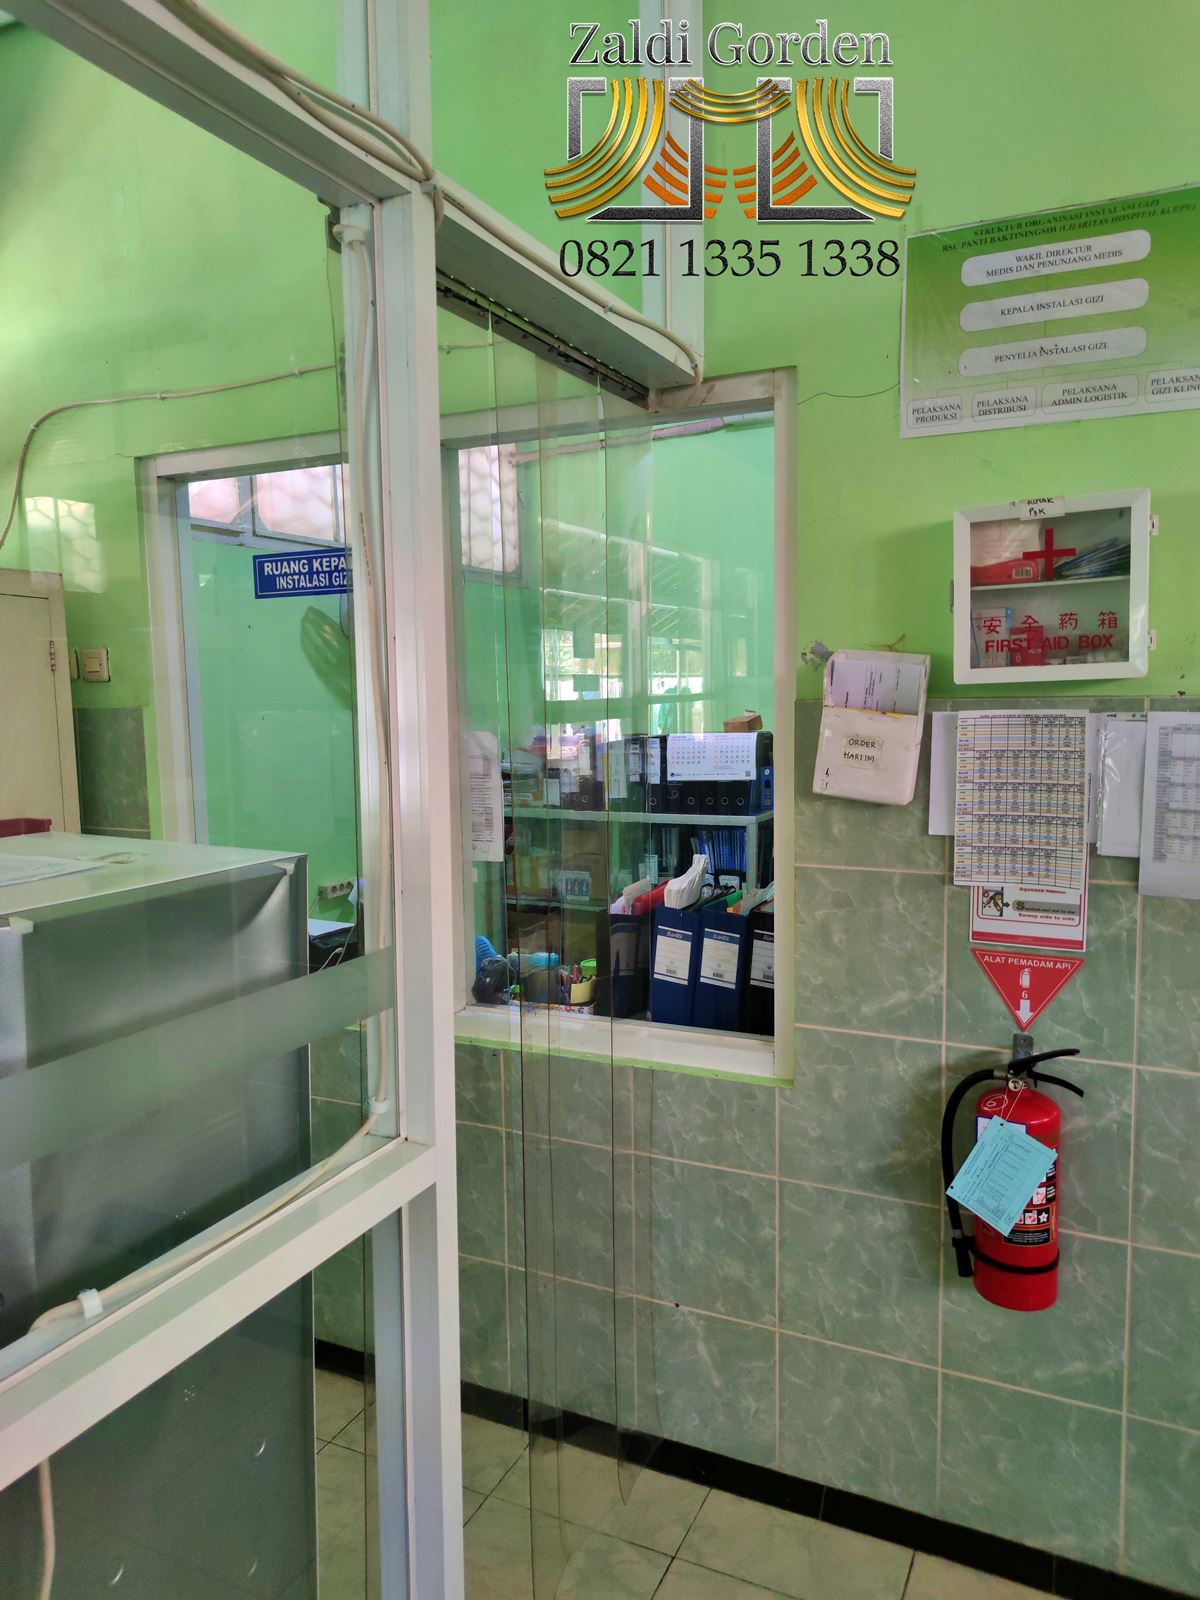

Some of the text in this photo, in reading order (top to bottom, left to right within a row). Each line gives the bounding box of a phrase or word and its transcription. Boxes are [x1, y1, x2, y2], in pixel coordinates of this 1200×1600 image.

[974, 198, 1160, 237] STRUKTUR ORGANISASI INSTALASI GIZI
[961, 238, 988, 248] PANTI
[1111, 209, 1157, 223] HOSPITAL
[1015, 245, 1093, 263] WAKIL DIREKTUR
[986, 249, 1124, 278] MEDIS DAN PENUNJANG MEDIS
[1000, 295, 1104, 317] KEPALA INSTALASI GIZI
[994, 341, 1107, 363] PENYELIA INSTALASI GIZI
[1062, 383, 1117, 396] PELAKSANA
[1151, 385, 1172, 395] GIZI
[976, 395, 1029, 409] PELAKSANA
[1051, 391, 1128, 407] ADMIN LOGISTIK
[912, 403, 962, 415] PELAKSANA
[978, 404, 1027, 417] DISTRIBUSI
[915, 412, 957, 424] PRODUKSI
[264, 560, 309, 576] RUANG
[276, 573, 329, 590] INSTALASI
[985, 638, 1033, 654] FIRST
[1043, 637, 1070, 650] AID
[1078, 634, 1114, 649] BOX
[848, 738, 877, 748] ORDER
[843, 752, 875, 763] HARI INI
[983, 955, 1071, 970] ALAT PEMADAM API
[1021, 990, 1028, 999] 6
